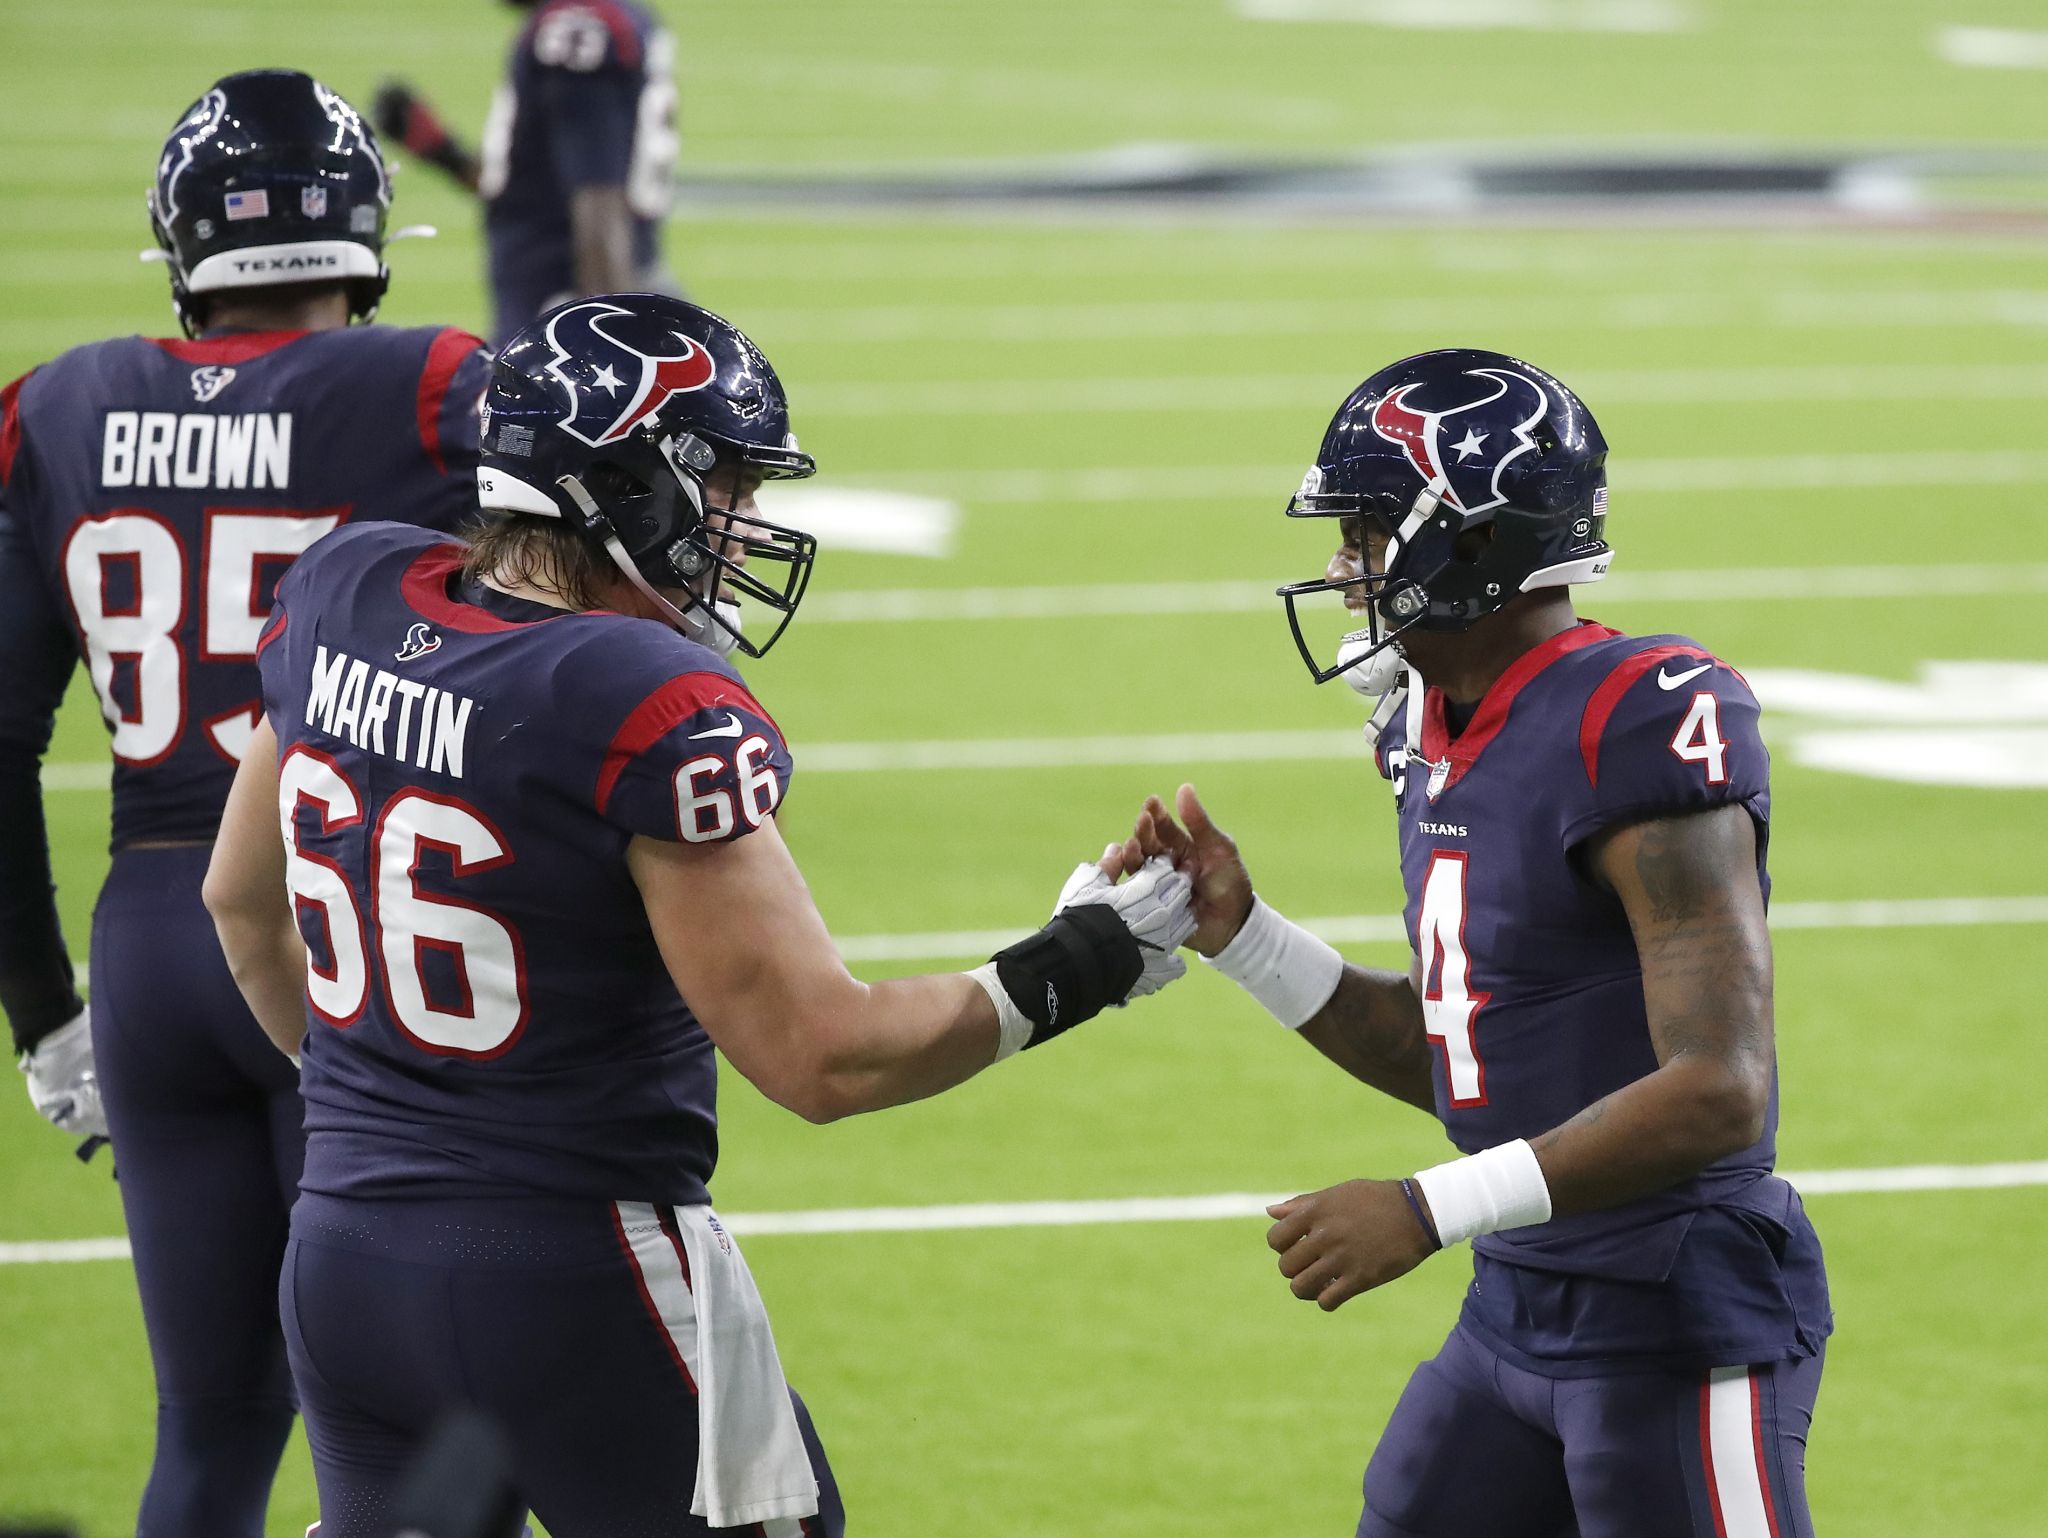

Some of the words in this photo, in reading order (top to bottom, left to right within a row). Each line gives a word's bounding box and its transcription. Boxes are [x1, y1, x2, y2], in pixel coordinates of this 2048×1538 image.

[233, 255, 338, 273] TEXANS
[102, 411, 293, 489] BROWN
[63, 505, 351, 768] 85
[305, 645, 474, 780] MARTIN
[1668, 690, 1732, 785] 4
[672, 733, 779, 844] 66
[1418, 821, 1468, 838] TEXANS
[279, 741, 531, 1062] 66
[1416, 848, 1493, 1111] 4
